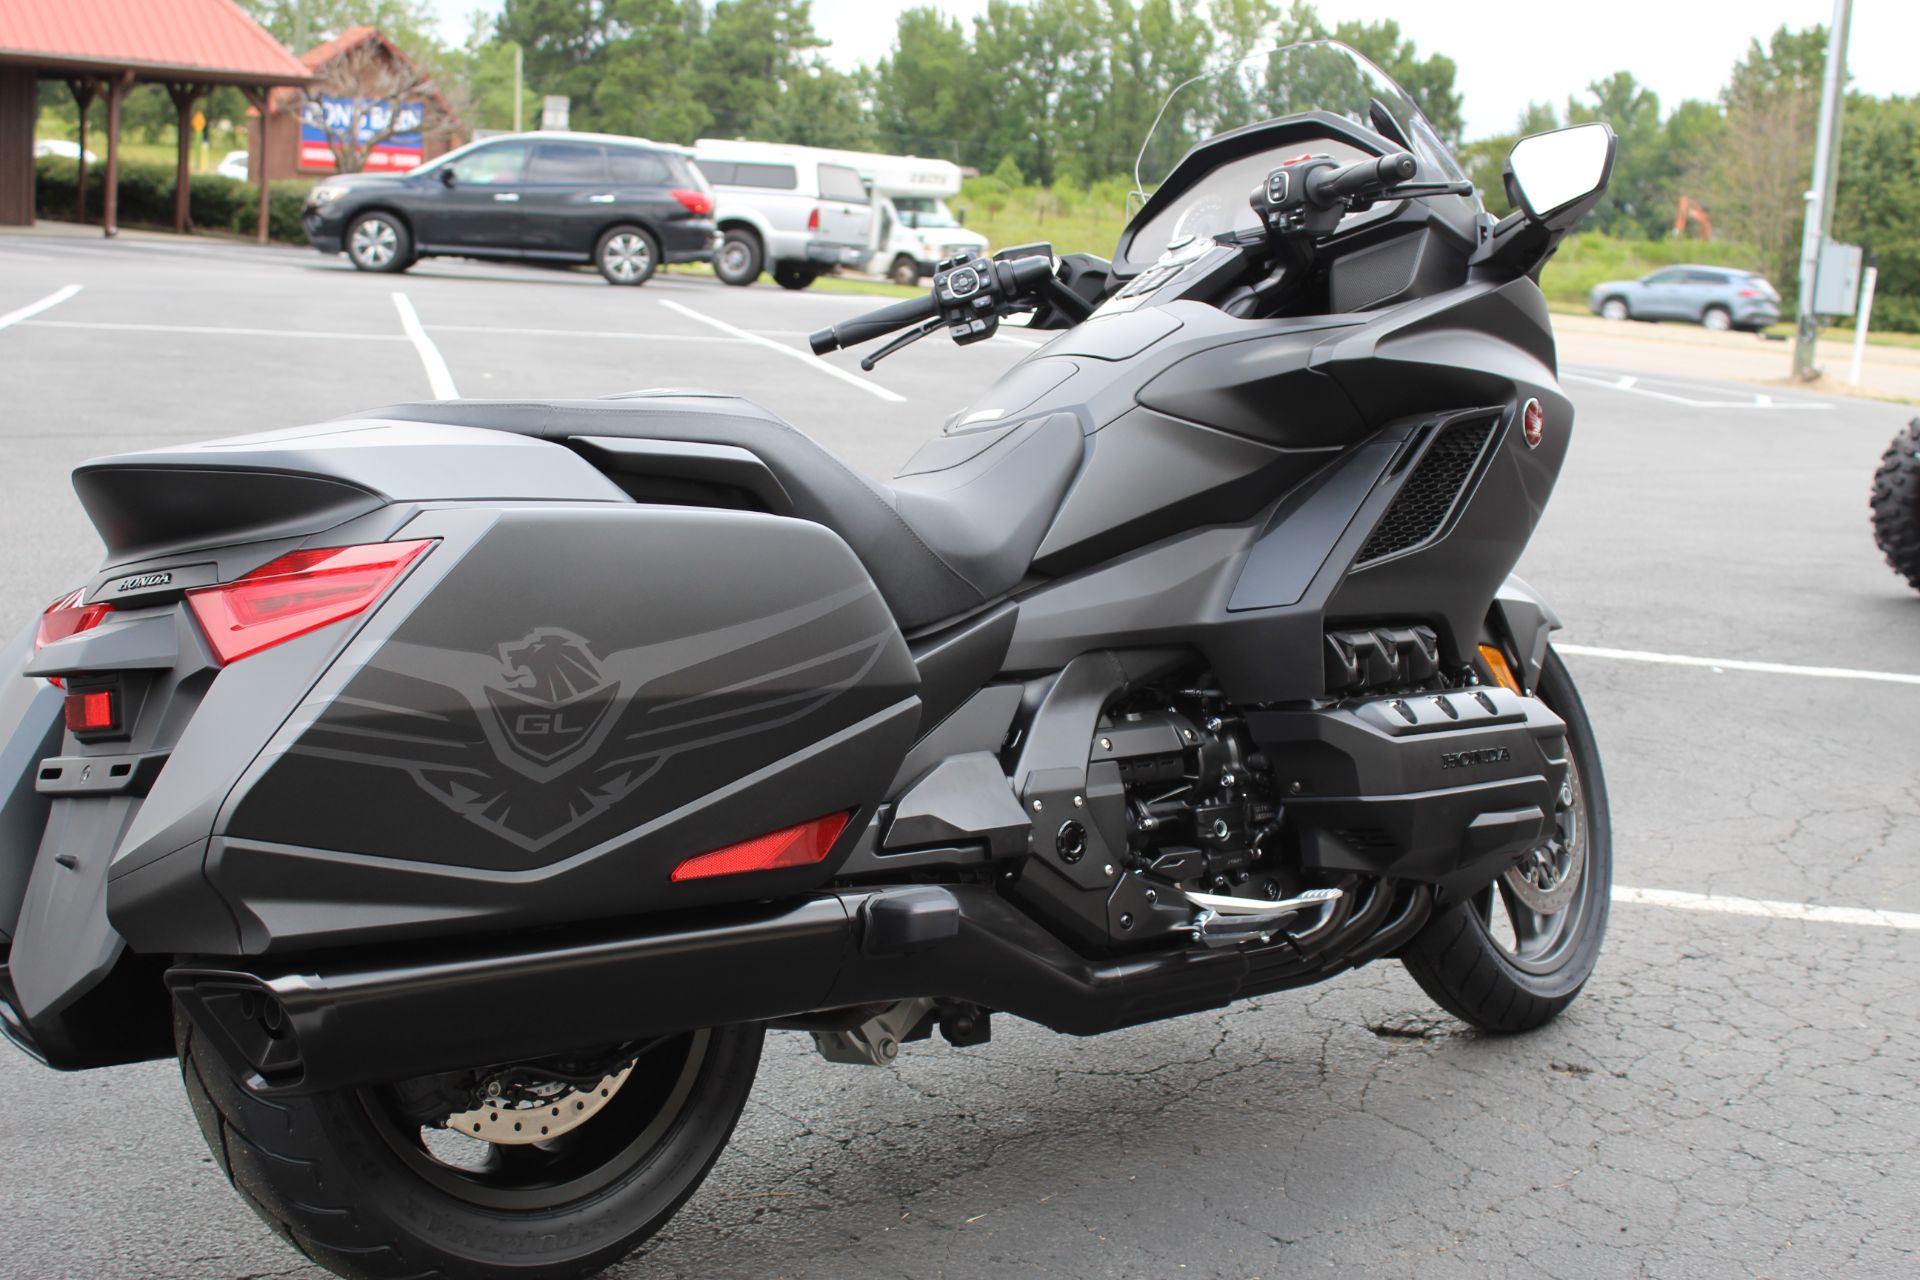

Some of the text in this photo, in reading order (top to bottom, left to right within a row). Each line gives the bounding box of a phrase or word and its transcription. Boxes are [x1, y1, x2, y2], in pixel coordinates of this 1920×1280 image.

[118, 573, 172, 591] HONDA
[516, 713, 583, 735] GL
[1441, 747, 1511, 769] HONDA
